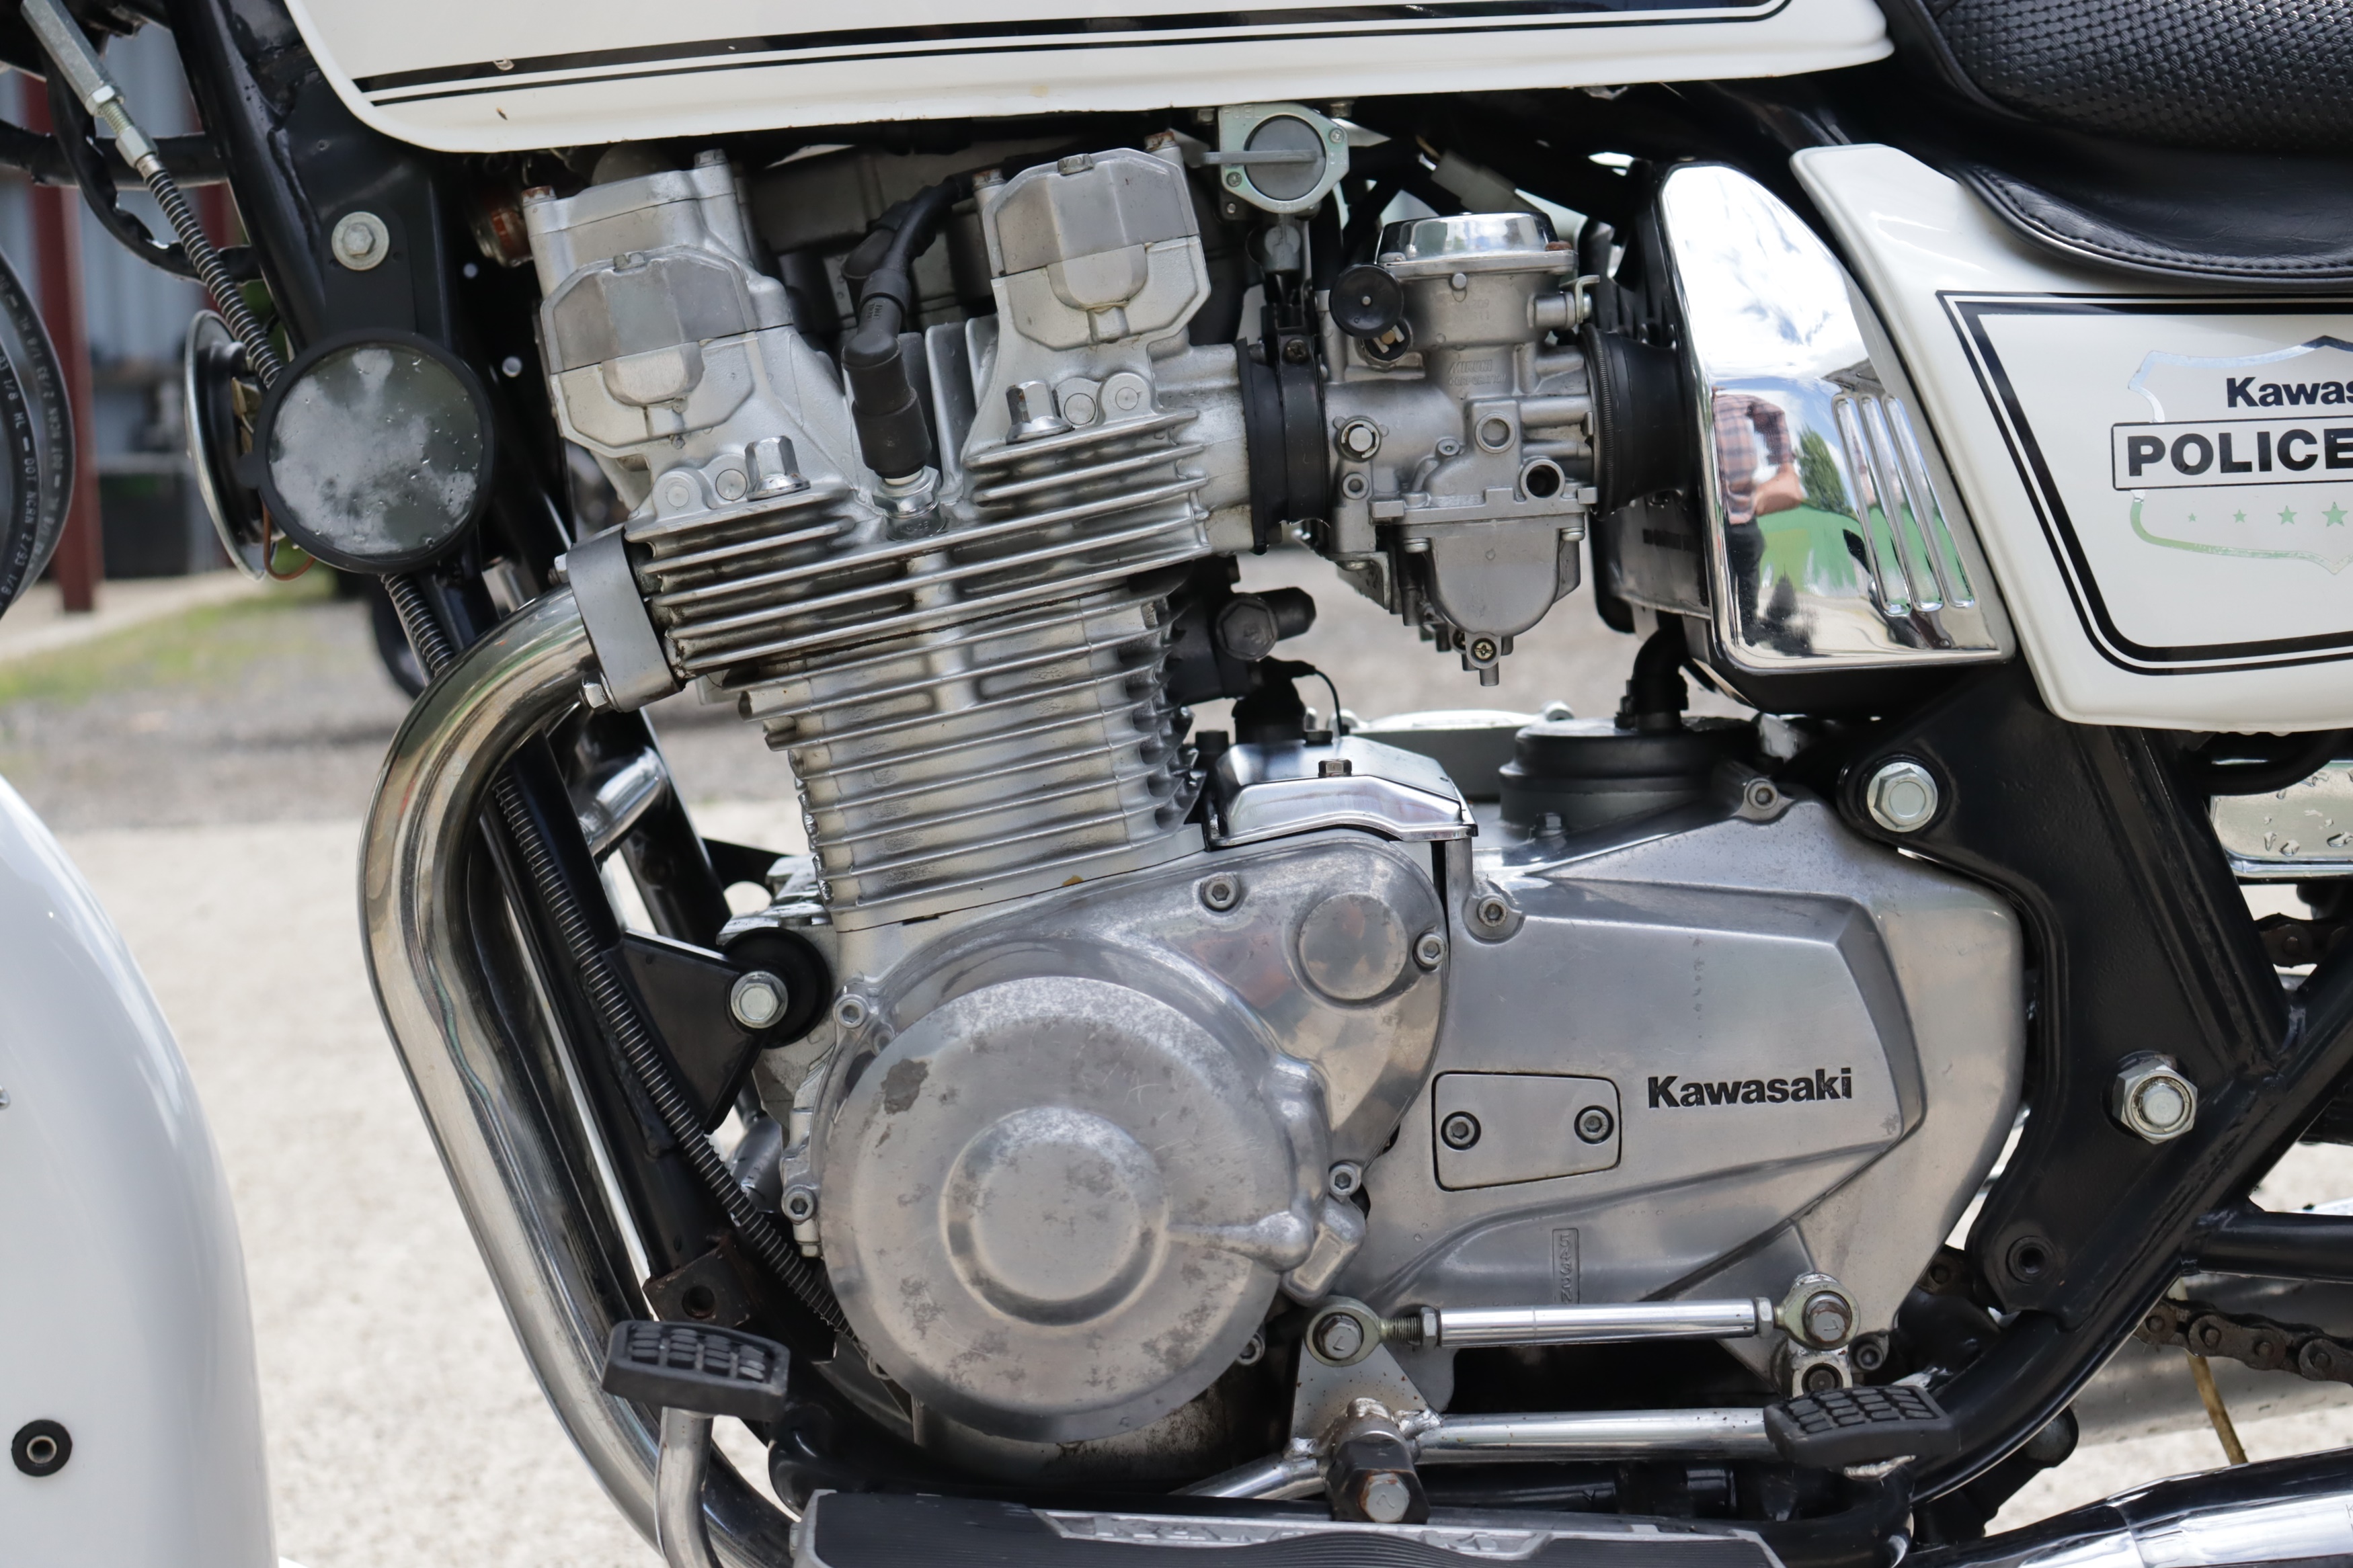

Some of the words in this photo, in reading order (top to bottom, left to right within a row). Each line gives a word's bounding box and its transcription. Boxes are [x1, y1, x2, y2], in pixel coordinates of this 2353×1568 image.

[1223, 105, 1263, 120] FUEL
[1449, 359, 1493, 374] MIKUNI
[2127, 427, 2353, 477] POLICE
[24, 457, 37, 481] DOT
[15, 532, 32, 566] 2/93
[1648, 1067, 1852, 1109] Kawasaki
